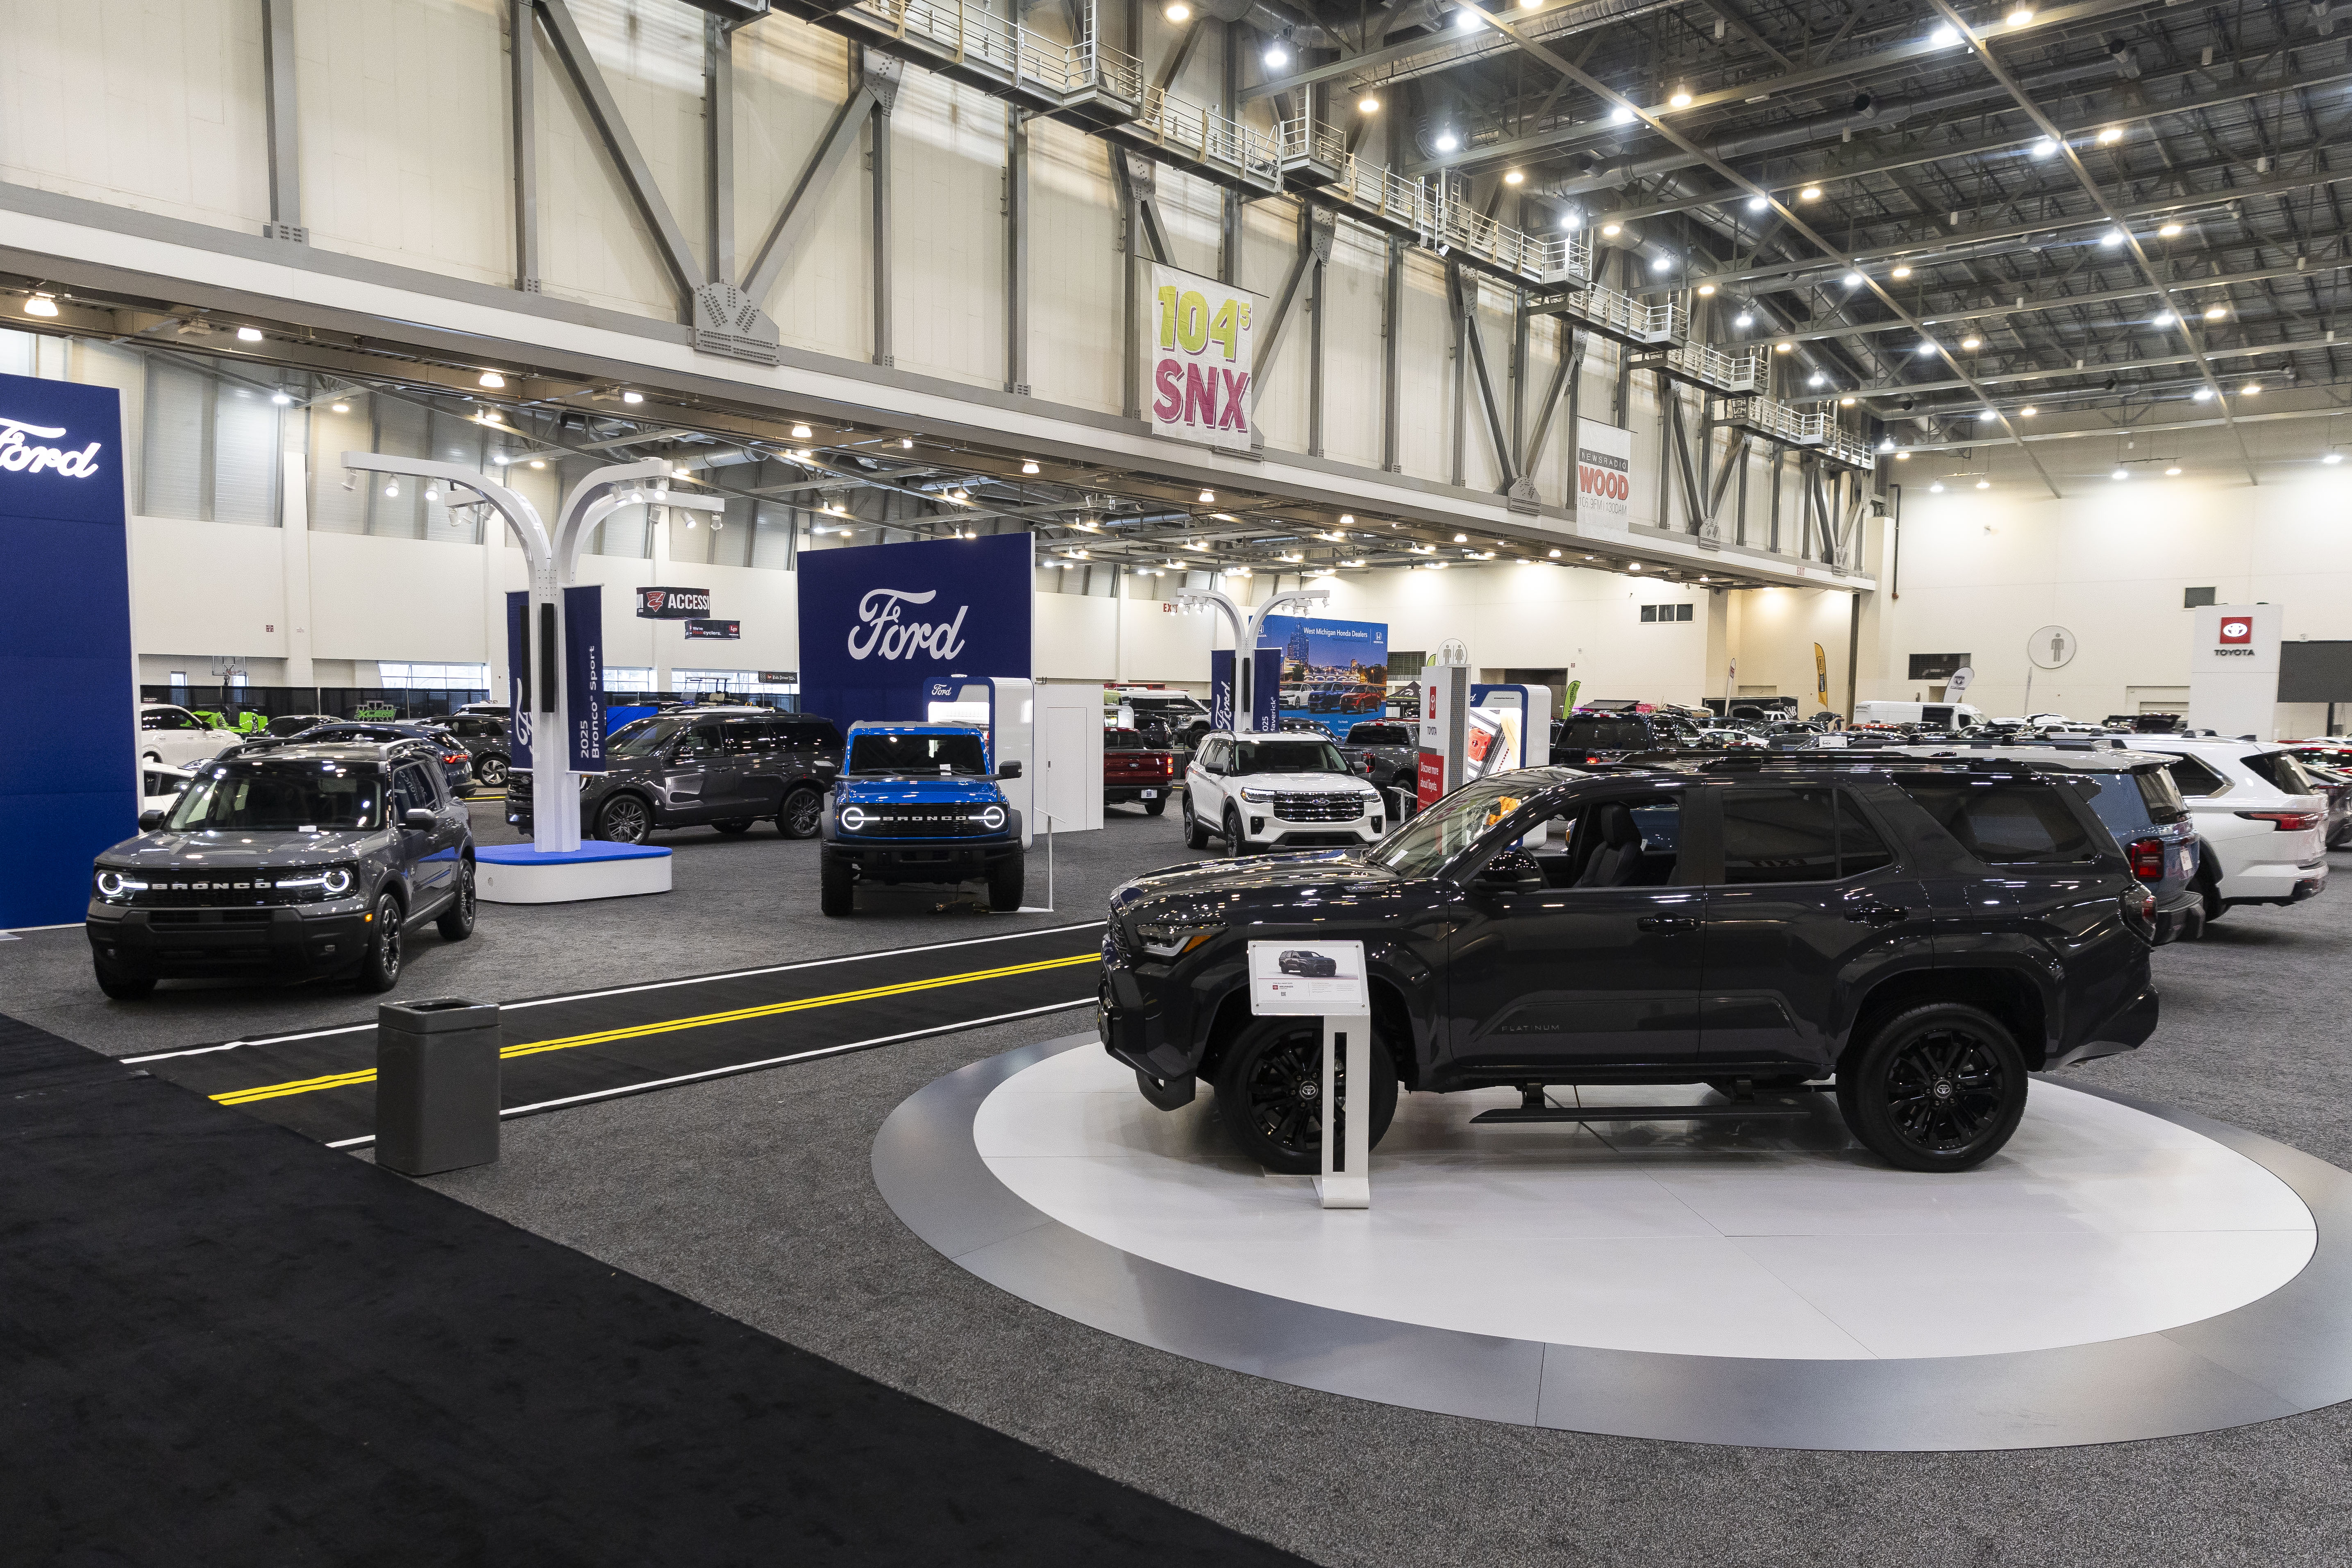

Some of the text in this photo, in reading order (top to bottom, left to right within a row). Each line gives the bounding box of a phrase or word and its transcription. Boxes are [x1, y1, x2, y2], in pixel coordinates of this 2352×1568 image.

[1153, 359, 1251, 433] SNX
[1582, 452, 1626, 469] NEWSRADIO
[1579, 465, 1629, 501] WOOD
[1163, 603, 1178, 613] EXT
[848, 589, 969, 660] Ford
[1316, 628, 1336, 637] Michigan
[931, 684, 952, 696] Ford
[1427, 726, 1437, 736] TOYOTA
[580, 720, 589, 758] 2025
[1421, 762, 1431, 774] Discover
[1428, 779, 1437, 792] Toyota.
